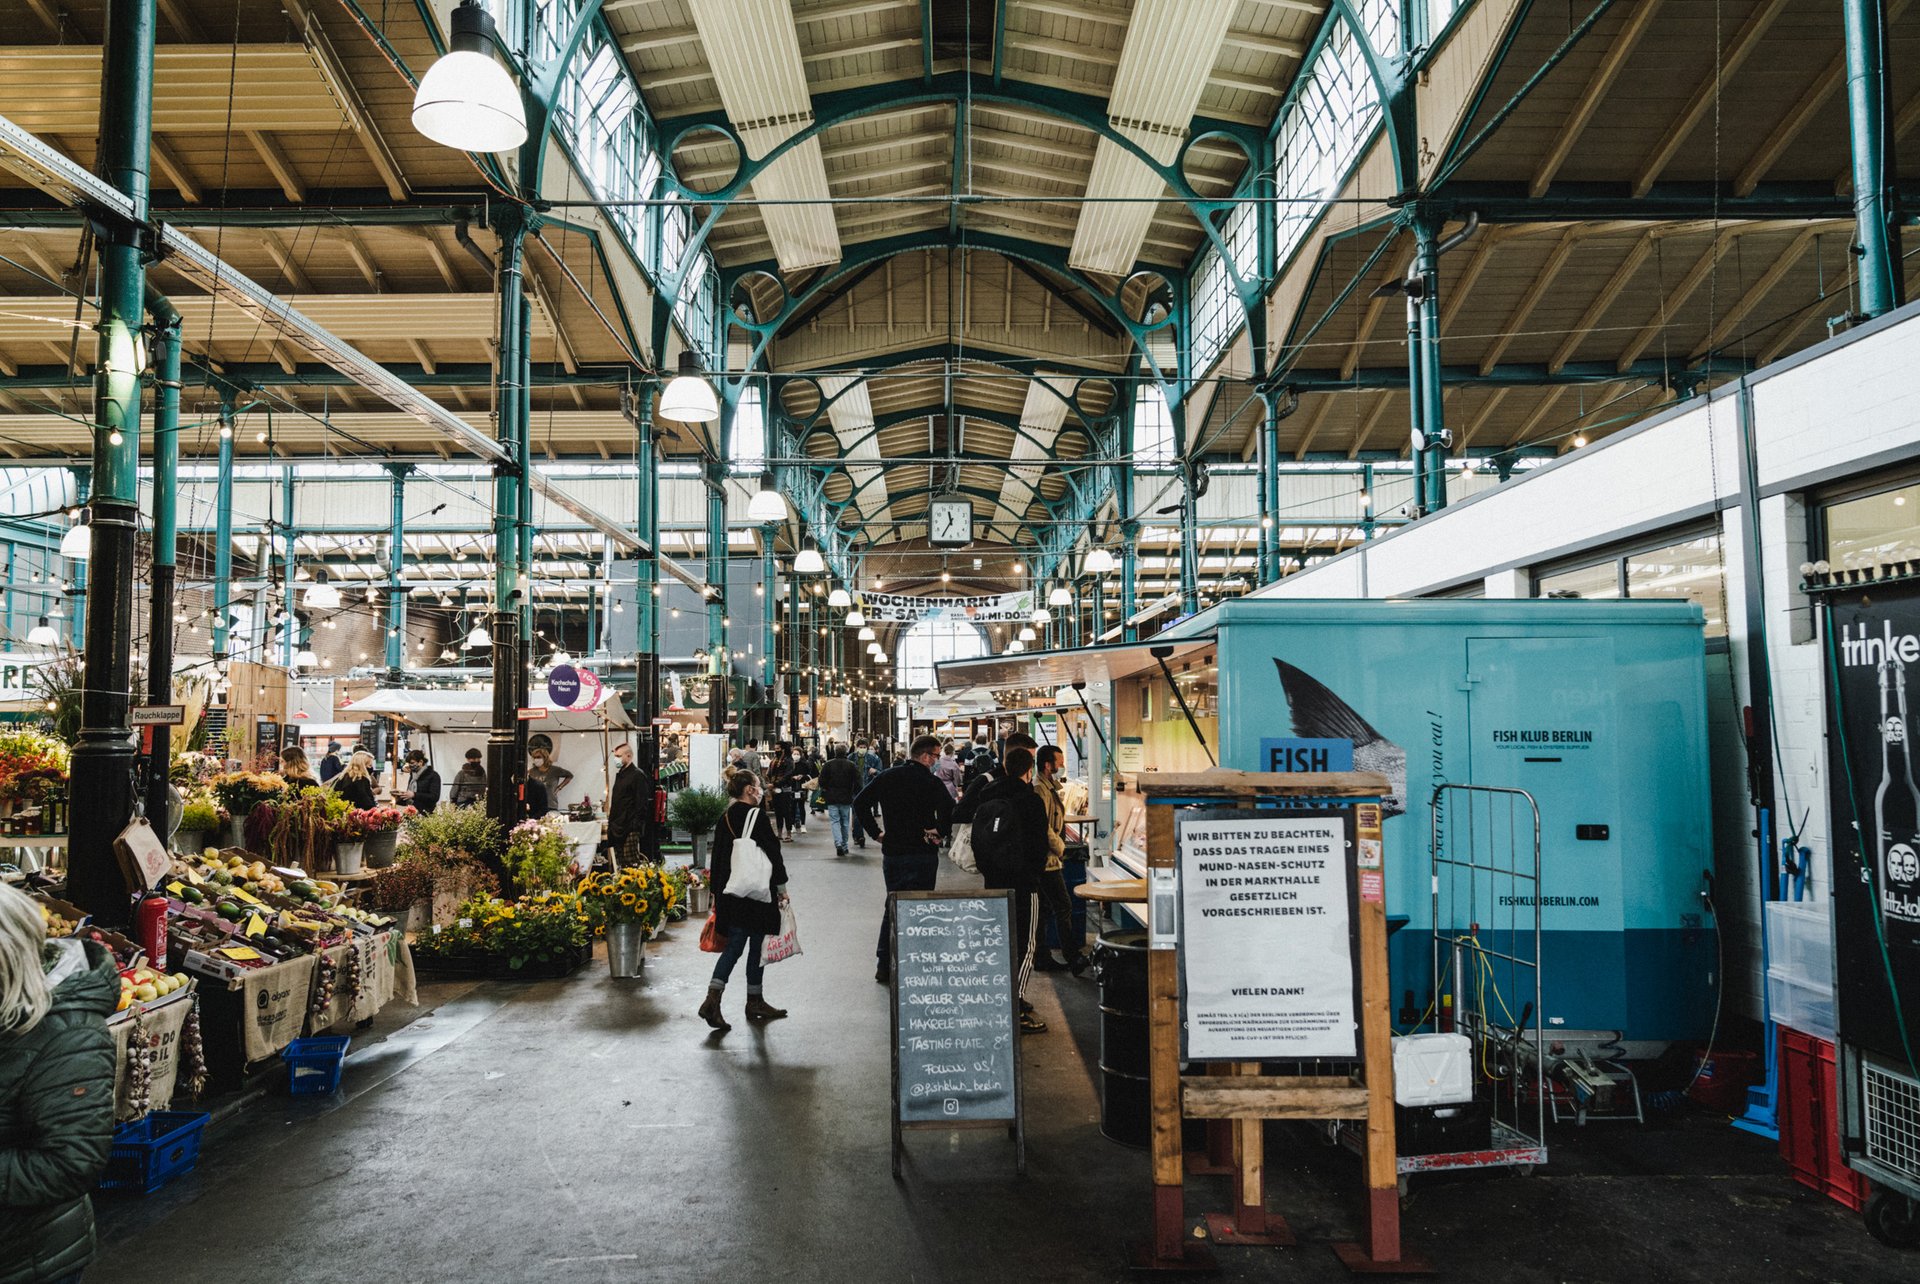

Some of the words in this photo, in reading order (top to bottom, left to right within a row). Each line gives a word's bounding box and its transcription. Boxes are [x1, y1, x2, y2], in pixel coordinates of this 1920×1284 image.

[861, 594, 1001, 607] WOCHENMARKT
[862, 607, 882, 619] FR
[896, 609, 918, 620] SA
[135, 712, 179, 720] Rauchklappe
[1431, 722, 1442, 746] eat
[1493, 730, 1518, 742] FISH
[1521, 730, 1549, 742] KLUB
[1552, 730, 1592, 742] BERLIN
[1270, 748, 1328, 772] FISH
[1433, 750, 1448, 782] you
[1212, 832, 1250, 840] BITTEN
[1254, 831, 1268, 839] ZU
[1272, 830, 1334, 839] BEACHTEN,
[1193, 848, 1222, 856] DASS
[1225, 847, 1247, 855] DAS
[1250, 846, 1294, 854] TRAGEN
[1298, 845, 1329, 854] EINES
[1199, 860, 1325, 871] MUND-NASEN-SCHUTZ
[1221, 878, 1242, 886] DER
[1245, 876, 1320, 885] MARKTHALLE
[1230, 892, 1297, 901] GESETZLICH
[1202, 907, 1303, 917] VORGESCHRIEBEN
[957, 925, 965, 936] 3
[958, 939, 966, 949] 6
[984, 937, 1003, 946] 10€
[768, 944, 793, 960] HAPPY
[940, 952, 970, 962] SOUP
[975, 951, 999, 965] 6€
[1232, 987, 1268, 996] VIELEN
[1271, 987, 1304, 996] DANK!
[958, 993, 994, 1005] SALAD
[162, 1030, 175, 1046] DO
[908, 1036, 952, 1052] TASTING
[955, 1038, 984, 1048] PLATE
